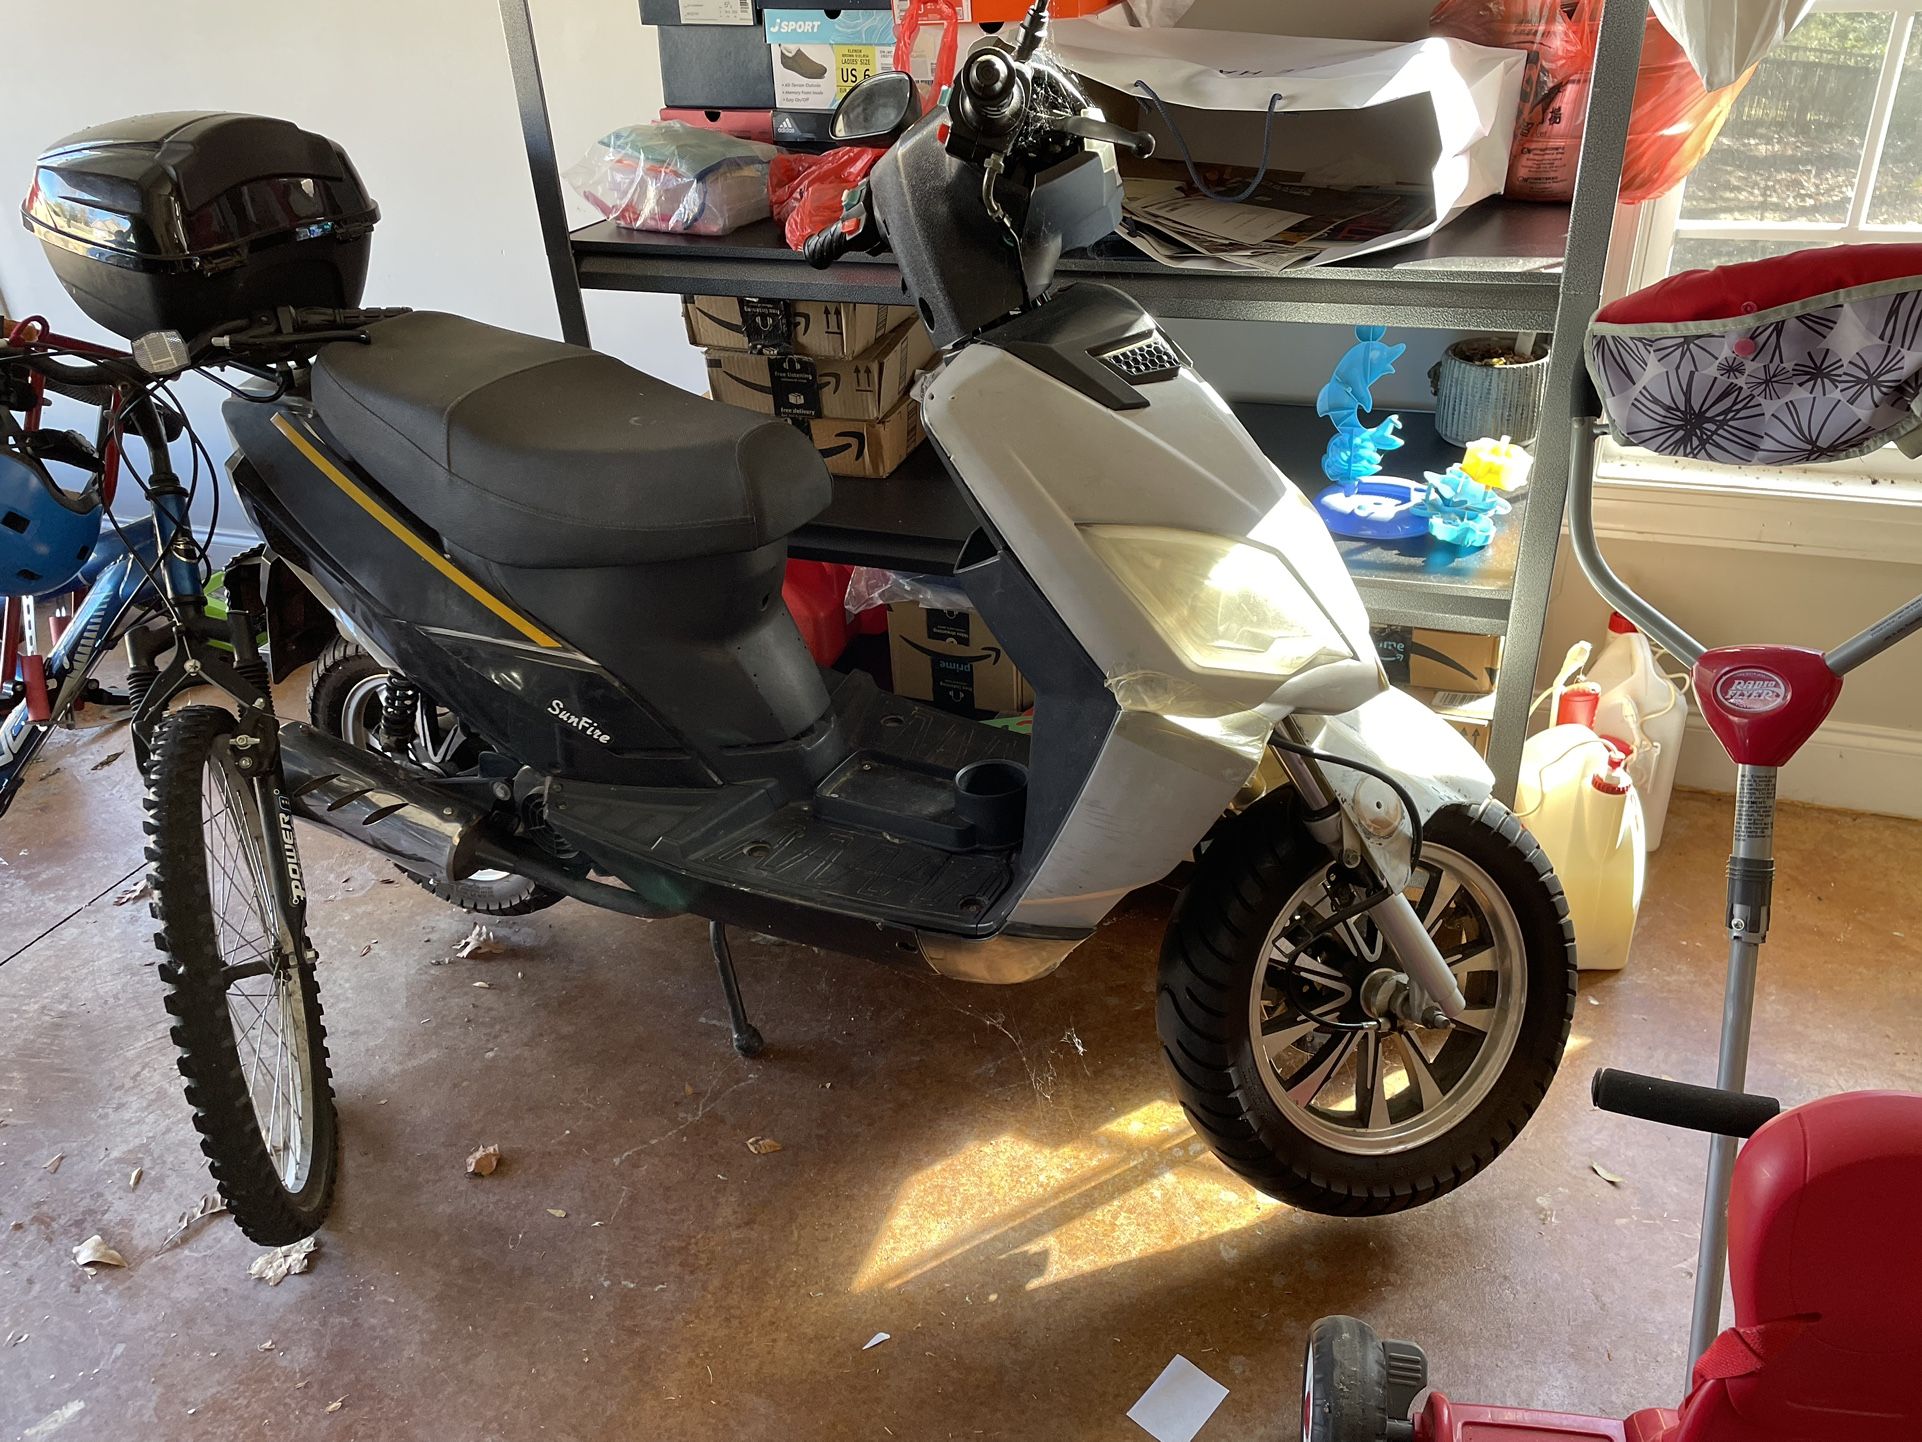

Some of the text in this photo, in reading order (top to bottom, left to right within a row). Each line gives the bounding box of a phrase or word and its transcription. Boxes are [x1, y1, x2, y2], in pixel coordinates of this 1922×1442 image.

[841, 68, 871, 83] US 6
[940, 660, 971, 672] prime
[1725, 690, 1774, 700] FLYER
[547, 699, 611, 743] SunFire
[279, 812, 306, 904] POWER
